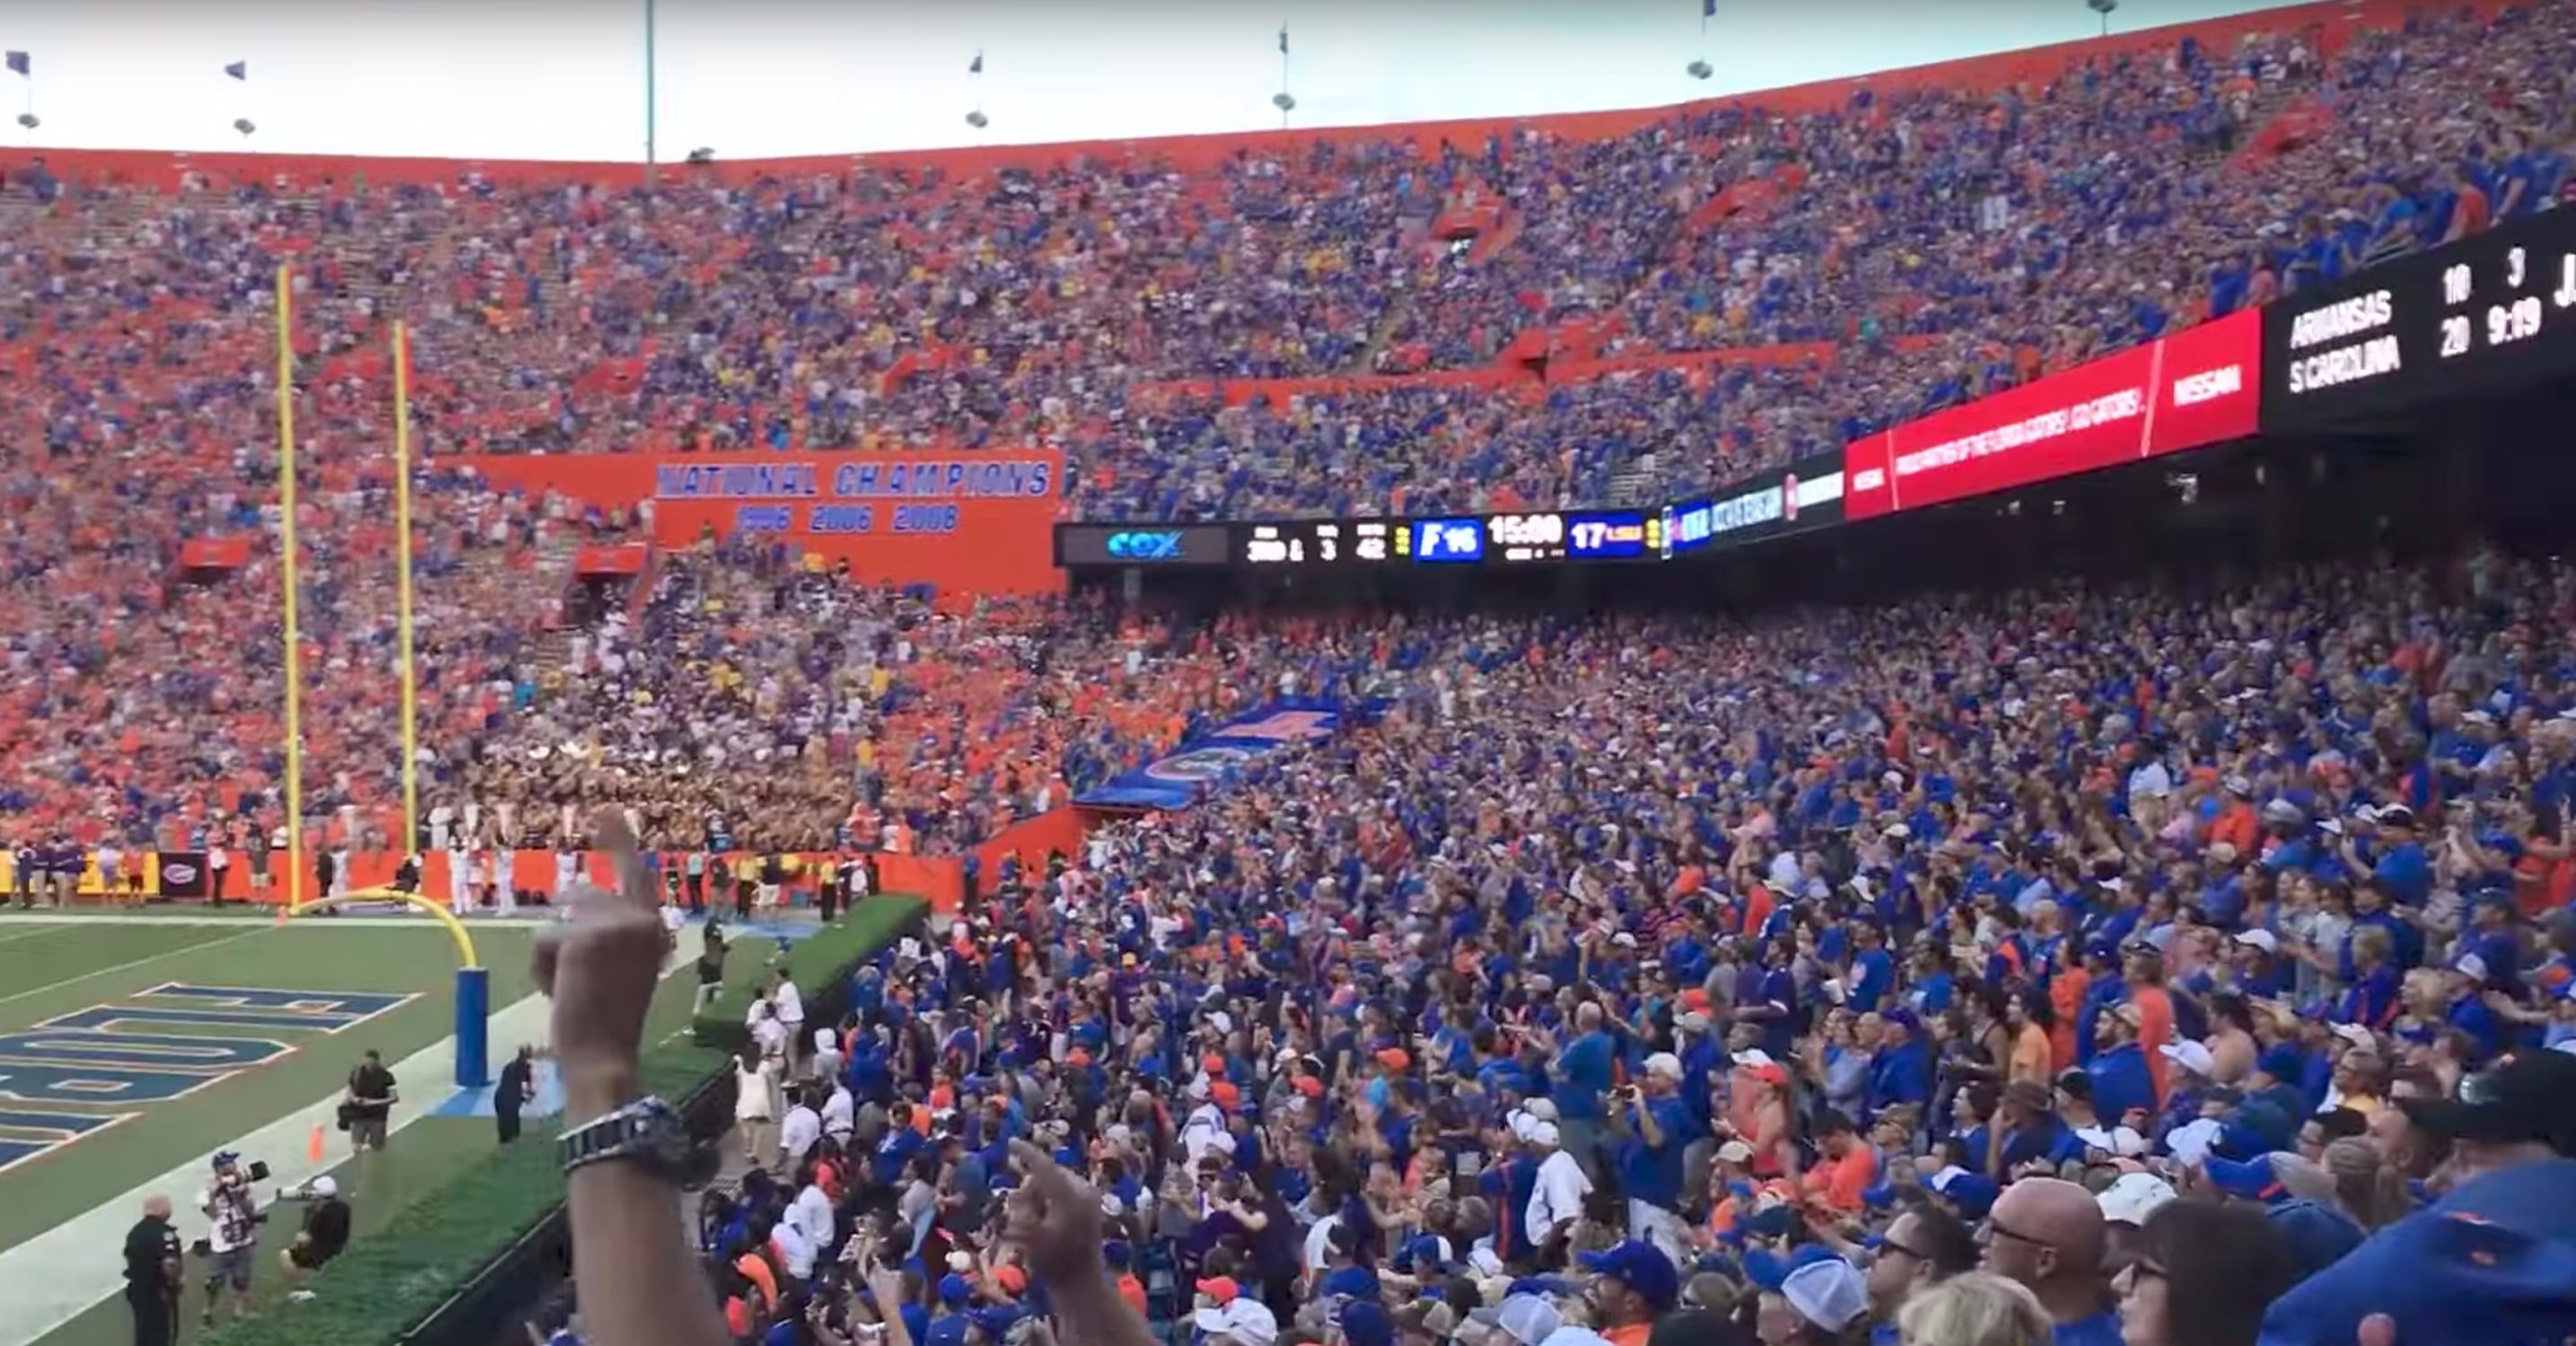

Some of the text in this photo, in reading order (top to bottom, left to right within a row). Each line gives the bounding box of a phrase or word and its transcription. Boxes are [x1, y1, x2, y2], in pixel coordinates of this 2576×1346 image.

[2291, 290, 2392, 349] ARKANSAS
[2443, 264, 2472, 305] 10
[2290, 362, 2304, 394] S
[2305, 335, 2402, 389] CAROLINA
[2440, 316, 2471, 358] 20
[2173, 363, 2241, 407] NISSAN
[656, 463, 1050, 498] NATIONAL CHAMPIONS
[810, 504, 872, 532] 2006
[894, 503, 959, 532] 2008
[1487, 514, 1563, 544] 15:00
[1571, 522, 1608, 549] 17
